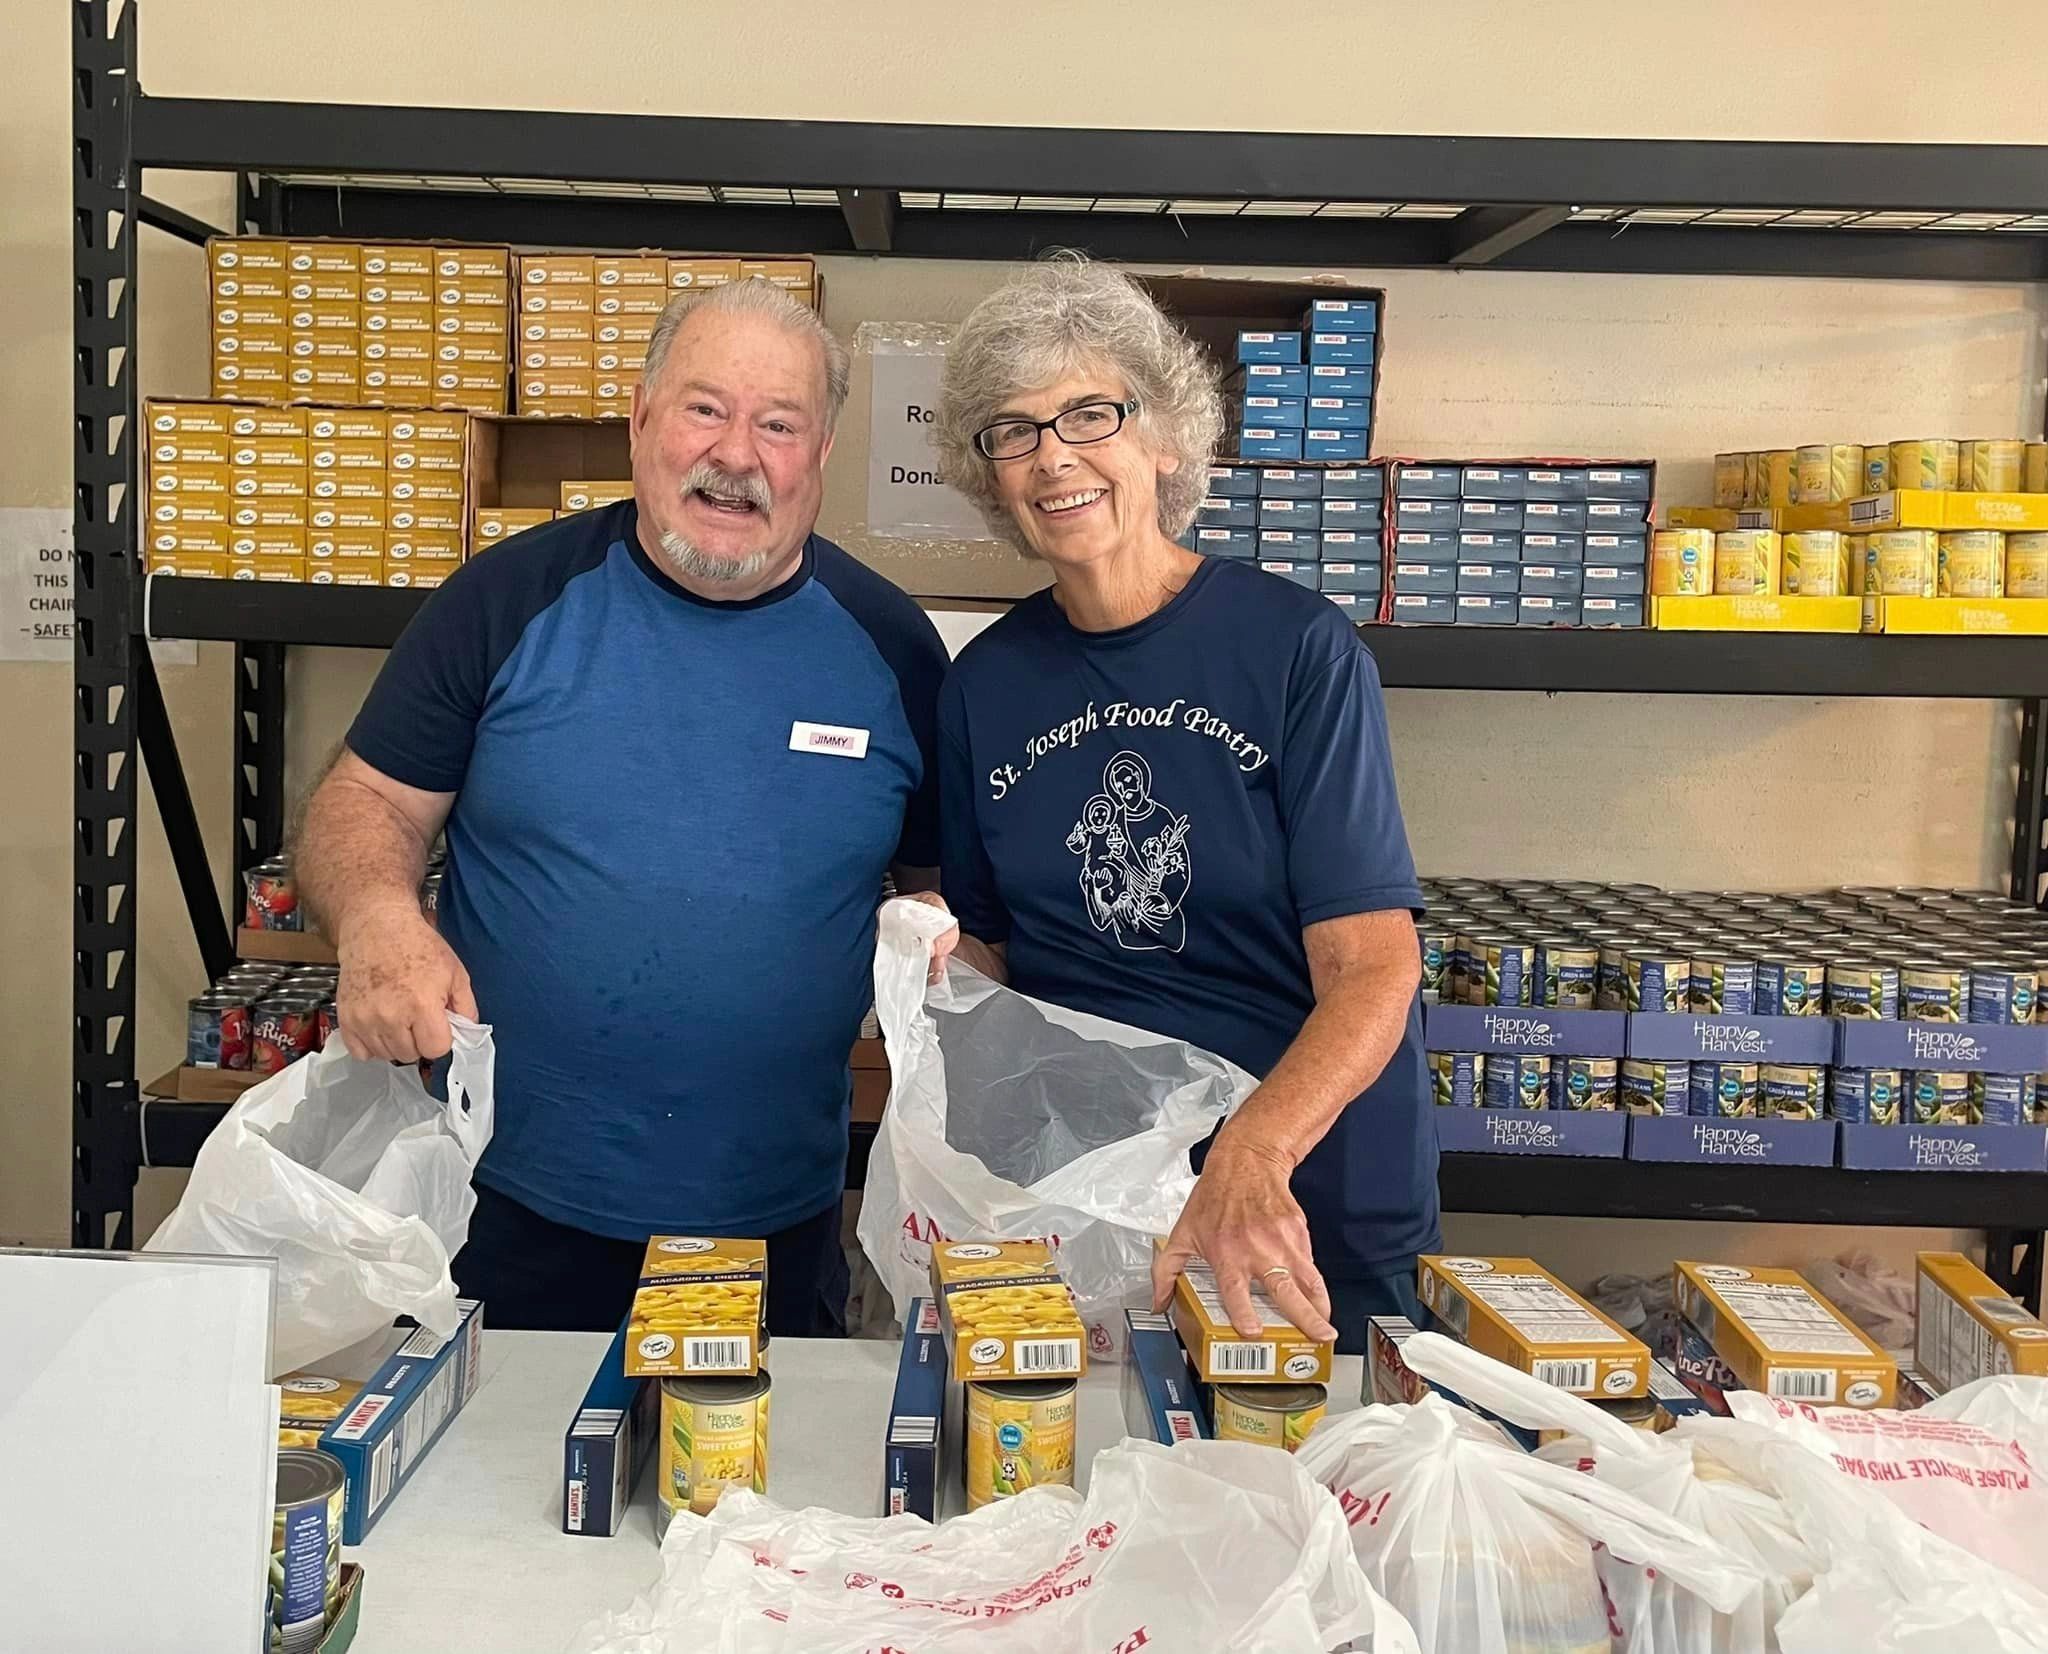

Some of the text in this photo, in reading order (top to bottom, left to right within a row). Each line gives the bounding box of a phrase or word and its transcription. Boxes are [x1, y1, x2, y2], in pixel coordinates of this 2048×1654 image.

[39, 549, 63, 562] DO
[33, 574, 68, 588] THIS
[814, 735, 849, 747] JIMMY
[989, 699, 1270, 800] St. Joseph Food Pantry
[1484, 1014, 1538, 1034] Happy
[1694, 1020, 1748, 1040] Happy
[1491, 1029, 1555, 1046] Harvest
[1701, 1036, 1766, 1053] Harvest
[1907, 1027, 1962, 1047] Happy
[1914, 1043, 1981, 1061] Harvest
[1486, 1115, 1540, 1135] Happy
[1694, 1124, 1748, 1143] Happy
[1493, 1130, 1558, 1147] Harvest
[1909, 1134, 1963, 1153] Happy
[1700, 1140, 1766, 1156] Harvest
[1916, 1149, 1982, 1166] Harvest
[650, 1276, 702, 1285] MACARONI
[956, 1279, 1006, 1291] MACARONI
[707, 1412, 737, 1423] Happy
[711, 1420, 745, 1430] Harvest
[696, 1442, 727, 1450] SWEET
[1868, 1459, 1906, 1481] THIS
